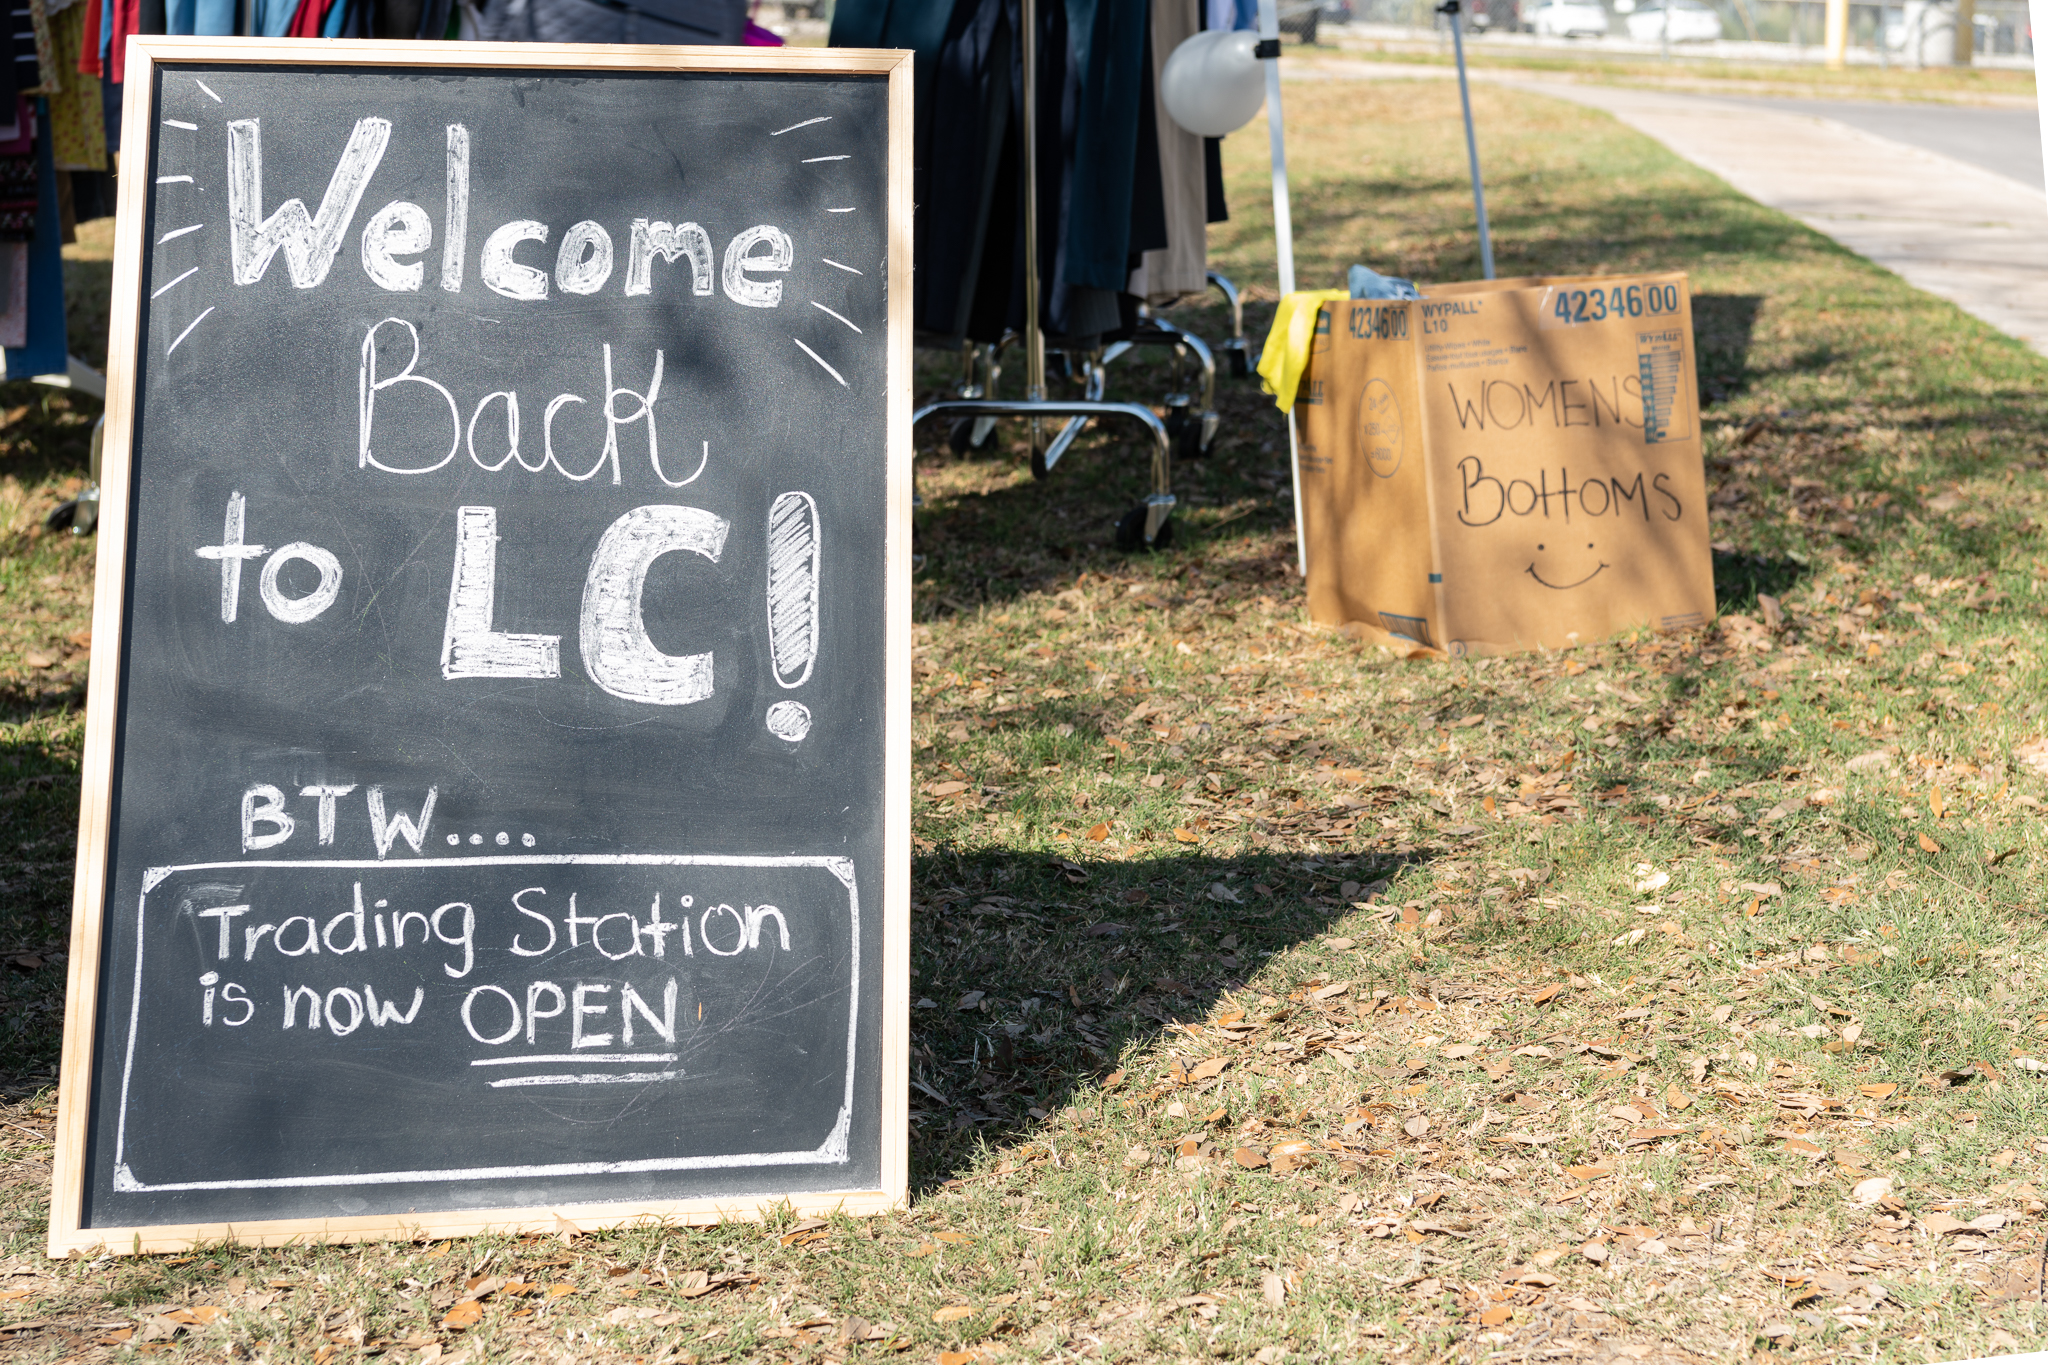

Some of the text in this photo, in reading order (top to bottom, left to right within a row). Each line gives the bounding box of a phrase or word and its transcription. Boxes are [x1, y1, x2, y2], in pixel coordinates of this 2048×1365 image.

[227, 116, 794, 308] Welcome
[1423, 318, 1448, 334] L10
[359, 317, 709, 488] Back
[1448, 374, 1650, 430] WOMENS
[195, 490, 821, 743] to LC!
[199, 881, 791, 978] Trading Station
[199, 970, 678, 1049] is now OPEN
